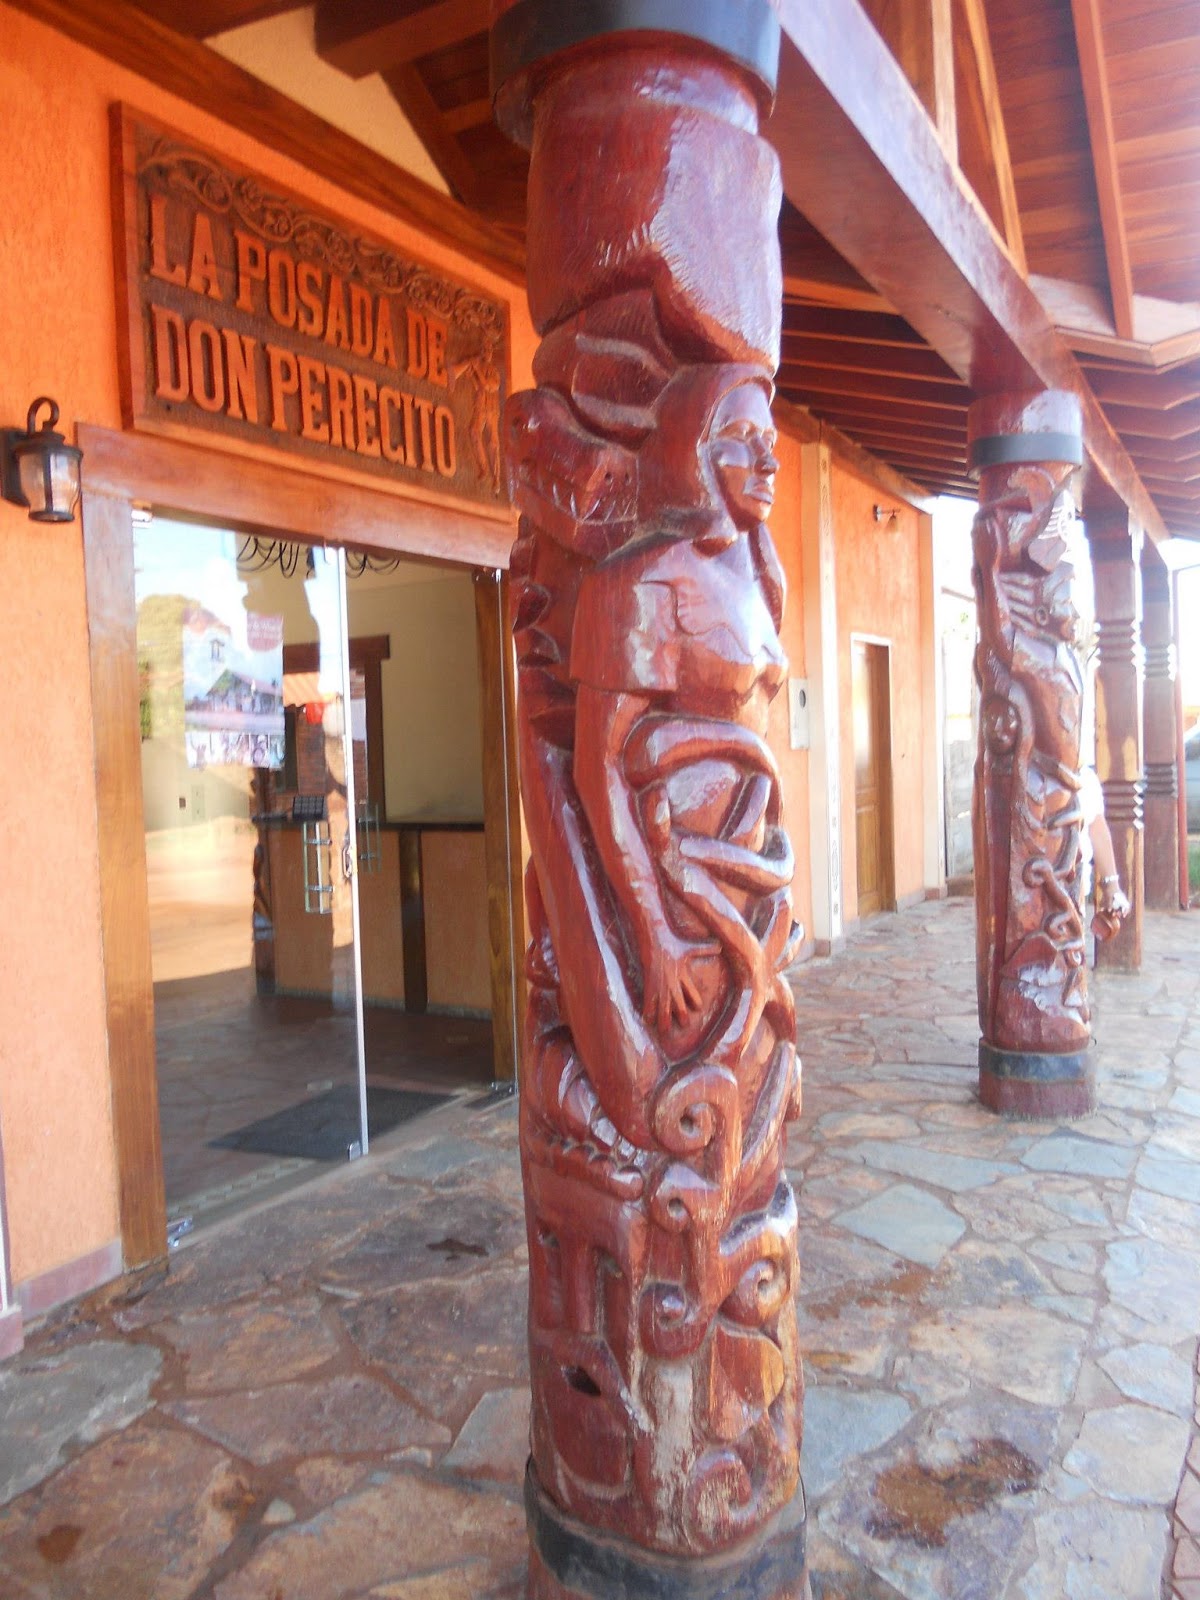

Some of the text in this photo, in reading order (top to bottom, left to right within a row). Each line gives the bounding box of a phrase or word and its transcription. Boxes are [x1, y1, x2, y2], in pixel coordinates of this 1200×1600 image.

[150, 197, 449, 388] LA POSADA DE
[151, 304, 457, 477] DON PERECITO
